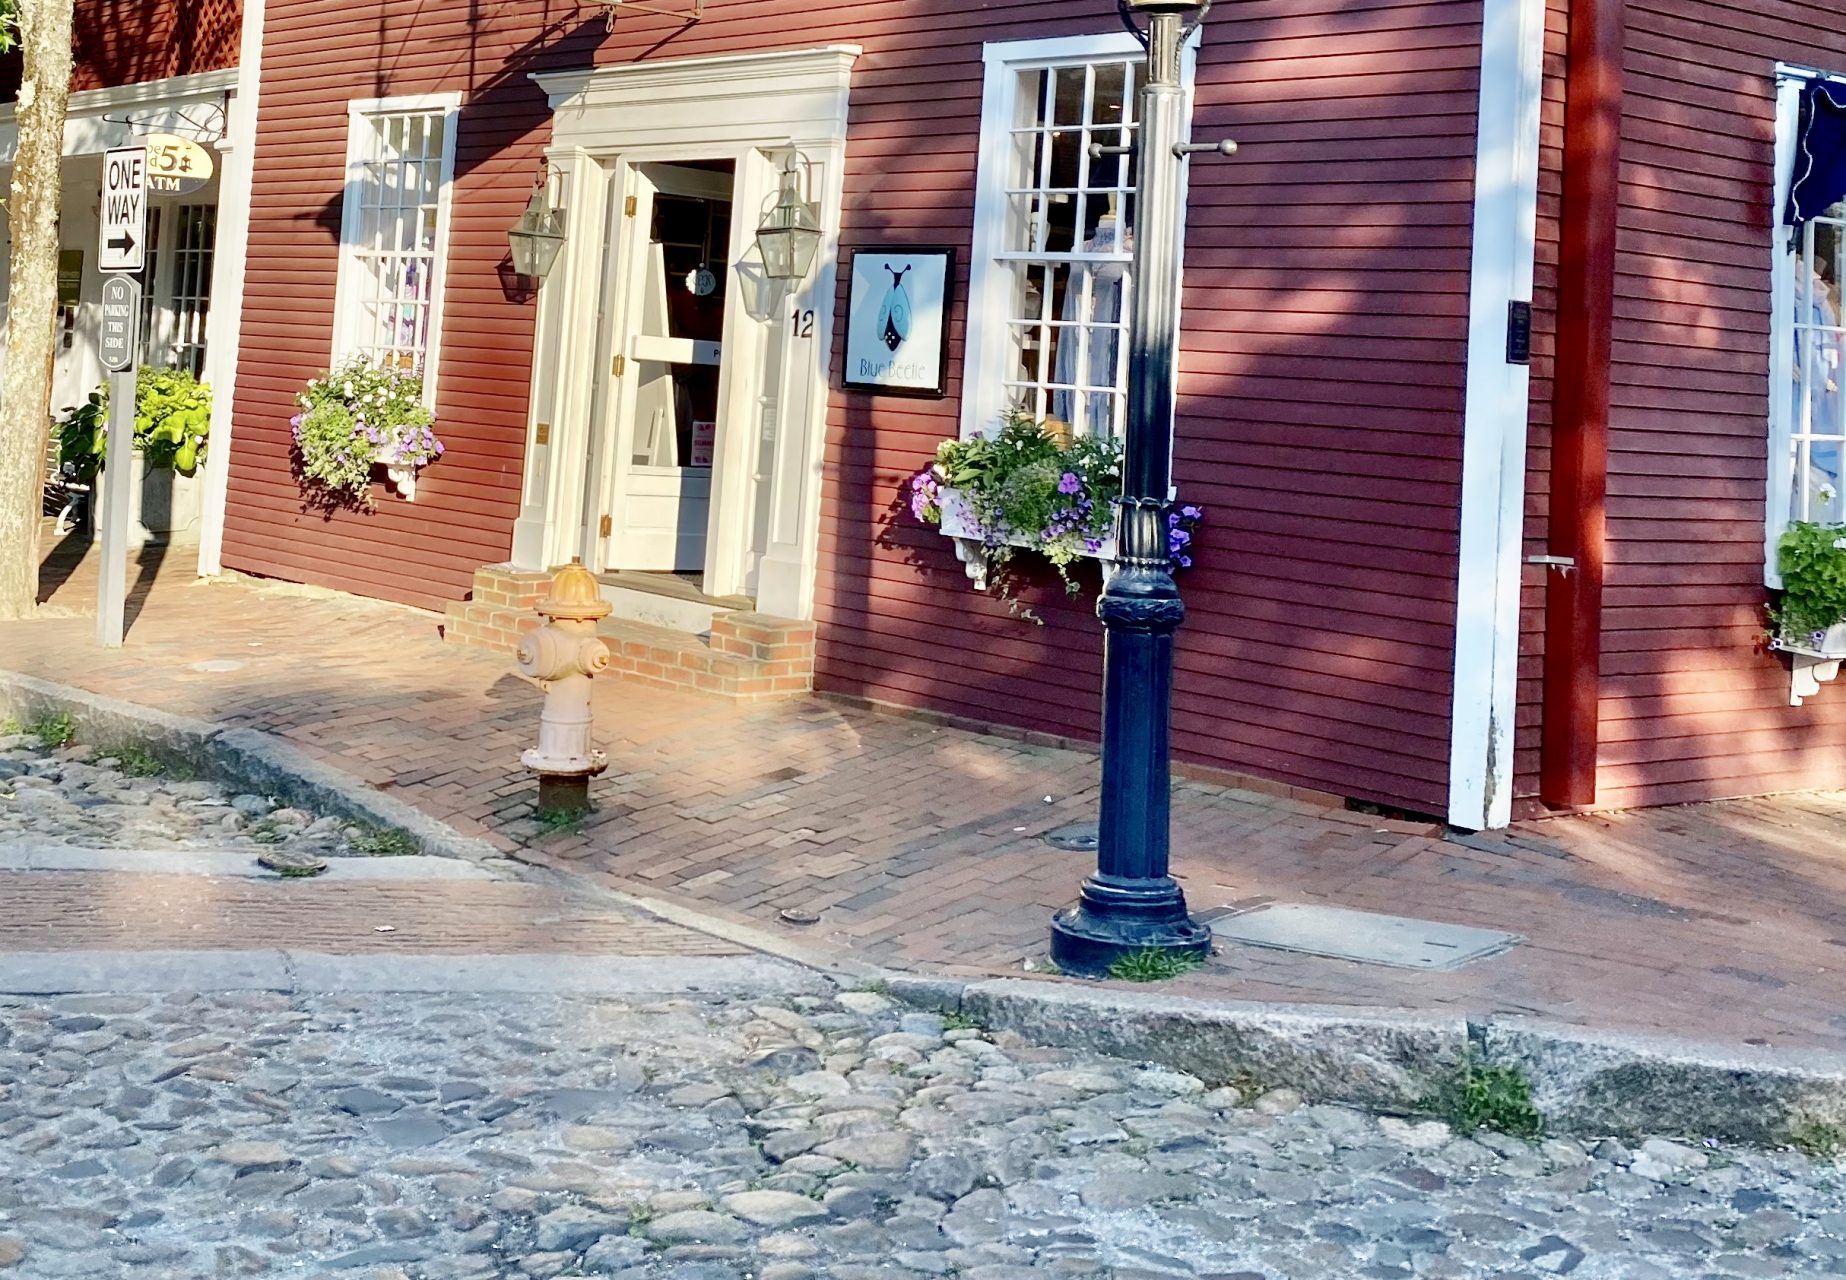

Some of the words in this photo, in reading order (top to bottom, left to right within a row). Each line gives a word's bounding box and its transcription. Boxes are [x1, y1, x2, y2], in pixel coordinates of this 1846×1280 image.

[160, 145, 179, 171] 5
[109, 159, 141, 191] ONE
[147, 175, 180, 191] ATM
[108, 194, 139, 225] WAY
[111, 286, 124, 300] NO
[104, 304, 129, 317] PARKING
[107, 321, 124, 333] THIS
[791, 309, 814, 338] 12
[104, 336, 124, 349] SIDE
[860, 358, 885, 377] Blue
[888, 360, 926, 380] Beetle
